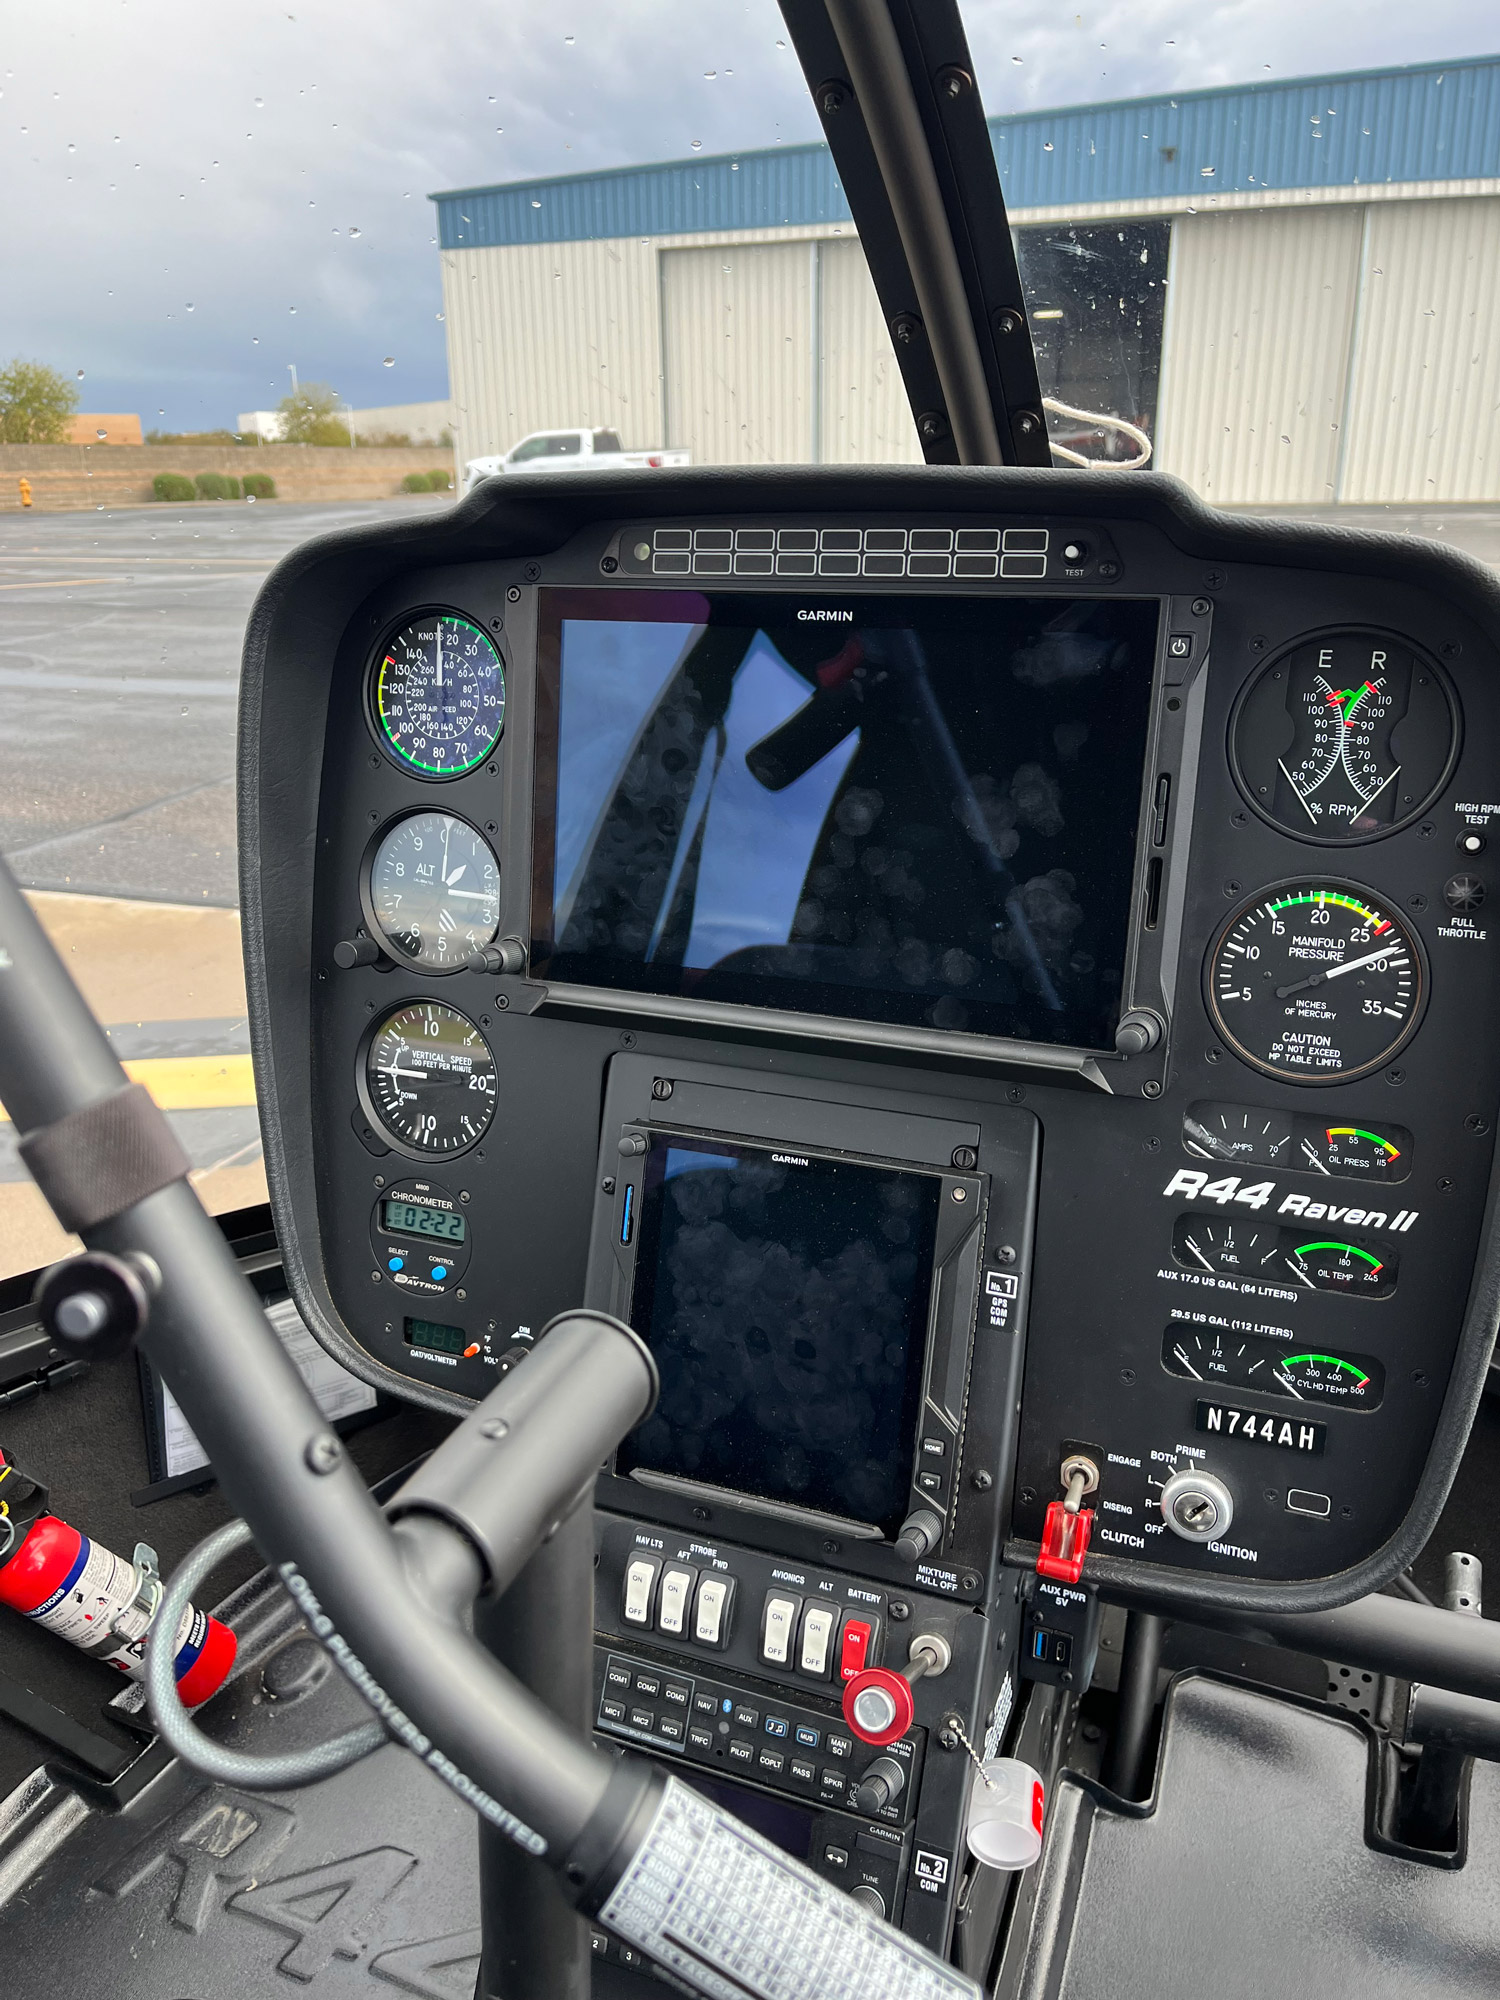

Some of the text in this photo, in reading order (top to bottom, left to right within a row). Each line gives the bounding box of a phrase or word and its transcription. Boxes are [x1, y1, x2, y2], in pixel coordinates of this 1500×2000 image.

[1065, 569, 1084, 577] TEST
[797, 610, 853, 622] GARMIN
[418, 632, 444, 640] KNOTS
[447, 635, 458, 645] 20
[407, 649, 422, 659] 140
[1319, 649, 1333, 668] E
[1371, 651, 1387, 670] R
[395, 665, 410, 675] 130
[478, 667, 491, 677] 40
[390, 684, 404, 694] 120
[484, 696, 496, 706] 50
[1308, 706, 1324, 715] 100
[399, 723, 413, 733] 100
[1315, 719, 1328, 728] 90
[475, 726, 487, 736] 60
[433, 748, 445, 758] 80
[1370, 777, 1384, 786] 50
[1329, 804, 1358, 816] RPM
[1455, 803, 1500, 814] HIGH RPM
[1465, 815, 1489, 824] TEST
[396, 863, 404, 876] 8
[416, 863, 435, 877] ALT
[484, 865, 492, 879] 2
[393, 894, 402, 908] 7
[1310, 911, 1330, 924] 20
[1451, 918, 1475, 927] FULL
[1272, 921, 1286, 935] 15
[1437, 927, 1486, 939] THROTTLE
[1350, 928, 1370, 942] 25
[1293, 936, 1345, 948] MANIFOLD
[1289, 947, 1344, 962] PRESSURE
[1296, 1000, 1326, 1009] INCHES
[1362, 1000, 1382, 1014] 35
[1298, 1009, 1337, 1020] MERCURY
[424, 1021, 439, 1036] 10
[463, 1038, 471, 1046] 15
[1282, 1032, 1331, 1046] CAUTION
[1272, 1043, 1340, 1058] DO NOT EXCEED
[412, 1050, 472, 1065] VERTICAL SPEED
[1269, 1052, 1342, 1067] MP TABLE LIMITS
[423, 1060, 438, 1068] FEET
[452, 1065, 472, 1073] MINUTE
[469, 1075, 486, 1090] 20
[401, 1092, 418, 1100] DOWN
[1232, 1143, 1253, 1152] AMPS
[772, 1154, 808, 1166] GARMIN
[1329, 1156, 1369, 1167] OIL PRESS
[392, 1191, 453, 1209] CHRONOMETER
[1163, 1169, 1419, 1232] R44 Raven II
[405, 1208, 461, 1236] 02:22
[388, 1247, 409, 1256] SELECT
[429, 1255, 455, 1266] CONTROL
[1221, 1254, 1240, 1264] FUEL
[1318, 1270, 1353, 1280] OIL TEMP
[1364, 1274, 1378, 1282] 245
[394, 1273, 444, 1292] DAVTRON
[991, 1279, 1011, 1293] No. 1
[1157, 1269, 1298, 1302] AUX 17.0 US GAL (64 LITERS)
[992, 1297, 1007, 1307] GPS
[990, 1306, 1007, 1317] COM
[990, 1316, 1005, 1326] NAV
[1170, 1309, 1294, 1340] 29.5 US GAL (112 LITERS)
[519, 1326, 530, 1334] DIM
[410, 1349, 457, 1366] OAT/VOLTMETER
[1209, 1362, 1227, 1372] FUEL
[1327, 1372, 1342, 1381] 400
[1297, 1379, 1348, 1394] CYL HD TEMP
[1350, 1386, 1365, 1395] 500
[1207, 1407, 1314, 1450] N744AH
[925, 1444, 941, 1452] HOME
[1176, 1444, 1206, 1459] PRIME
[1108, 1454, 1141, 1468] ENGAGE
[1150, 1450, 1178, 1464] BOTH
[1148, 1475, 1154, 1484] L
[1103, 1501, 1132, 1514] DISENG
[1145, 1499, 1152, 1508] R
[1144, 1523, 1164, 1535] OFF
[636, 1535, 664, 1550] NAV LTS
[1100, 1529, 1144, 1548] CLUTCH
[677, 1550, 691, 1561] AFT
[690, 1543, 717, 1557] STROBE
[1207, 1540, 1258, 1562] IGNITION
[712, 1559, 728, 1570] FWD
[632, 1574, 643, 1582] ON
[772, 1569, 805, 1585] AVIONICS
[918, 1565, 957, 1582] MIXTURE
[819, 1581, 834, 1592] ALT
[916, 1575, 958, 1592] PULL OFF
[848, 1588, 881, 1604] BATTERY
[1040, 1583, 1086, 1602] AUX PWR
[1056, 1597, 1068, 1607] 5V
[772, 1613, 783, 1622] ON
[848, 1633, 860, 1643] ON
[768, 1647, 782, 1656] OFF
[609, 1672, 628, 1685] COM1
[637, 1680, 656, 1694] COM2
[665, 1689, 685, 1703] COM3
[698, 1700, 712, 1711] NAV
[605, 1706, 622, 1718] MIC1
[739, 1713, 753, 1723] AUX
[633, 1714, 649, 1726] MIC2
[662, 1723, 678, 1736] MIC3
[691, 1733, 708, 1746] TRFC
[800, 1733, 814, 1743] MUS
[831, 1738, 847, 1749] MAN
[730, 1745, 750, 1759] PILOT
[832, 1746, 843, 1756] SQ
[760, 1755, 782, 1769] COPLT
[792, 1765, 811, 1778] PASS
[823, 1776, 843, 1789] SPKR
[426, 1749, 548, 1856] PROHIBITED
[869, 1826, 900, 1841] GARMIN
[921, 1860, 942, 1877] No. 2
[863, 1873, 879, 1884] TUNE
[920, 1879, 938, 1893] COM
